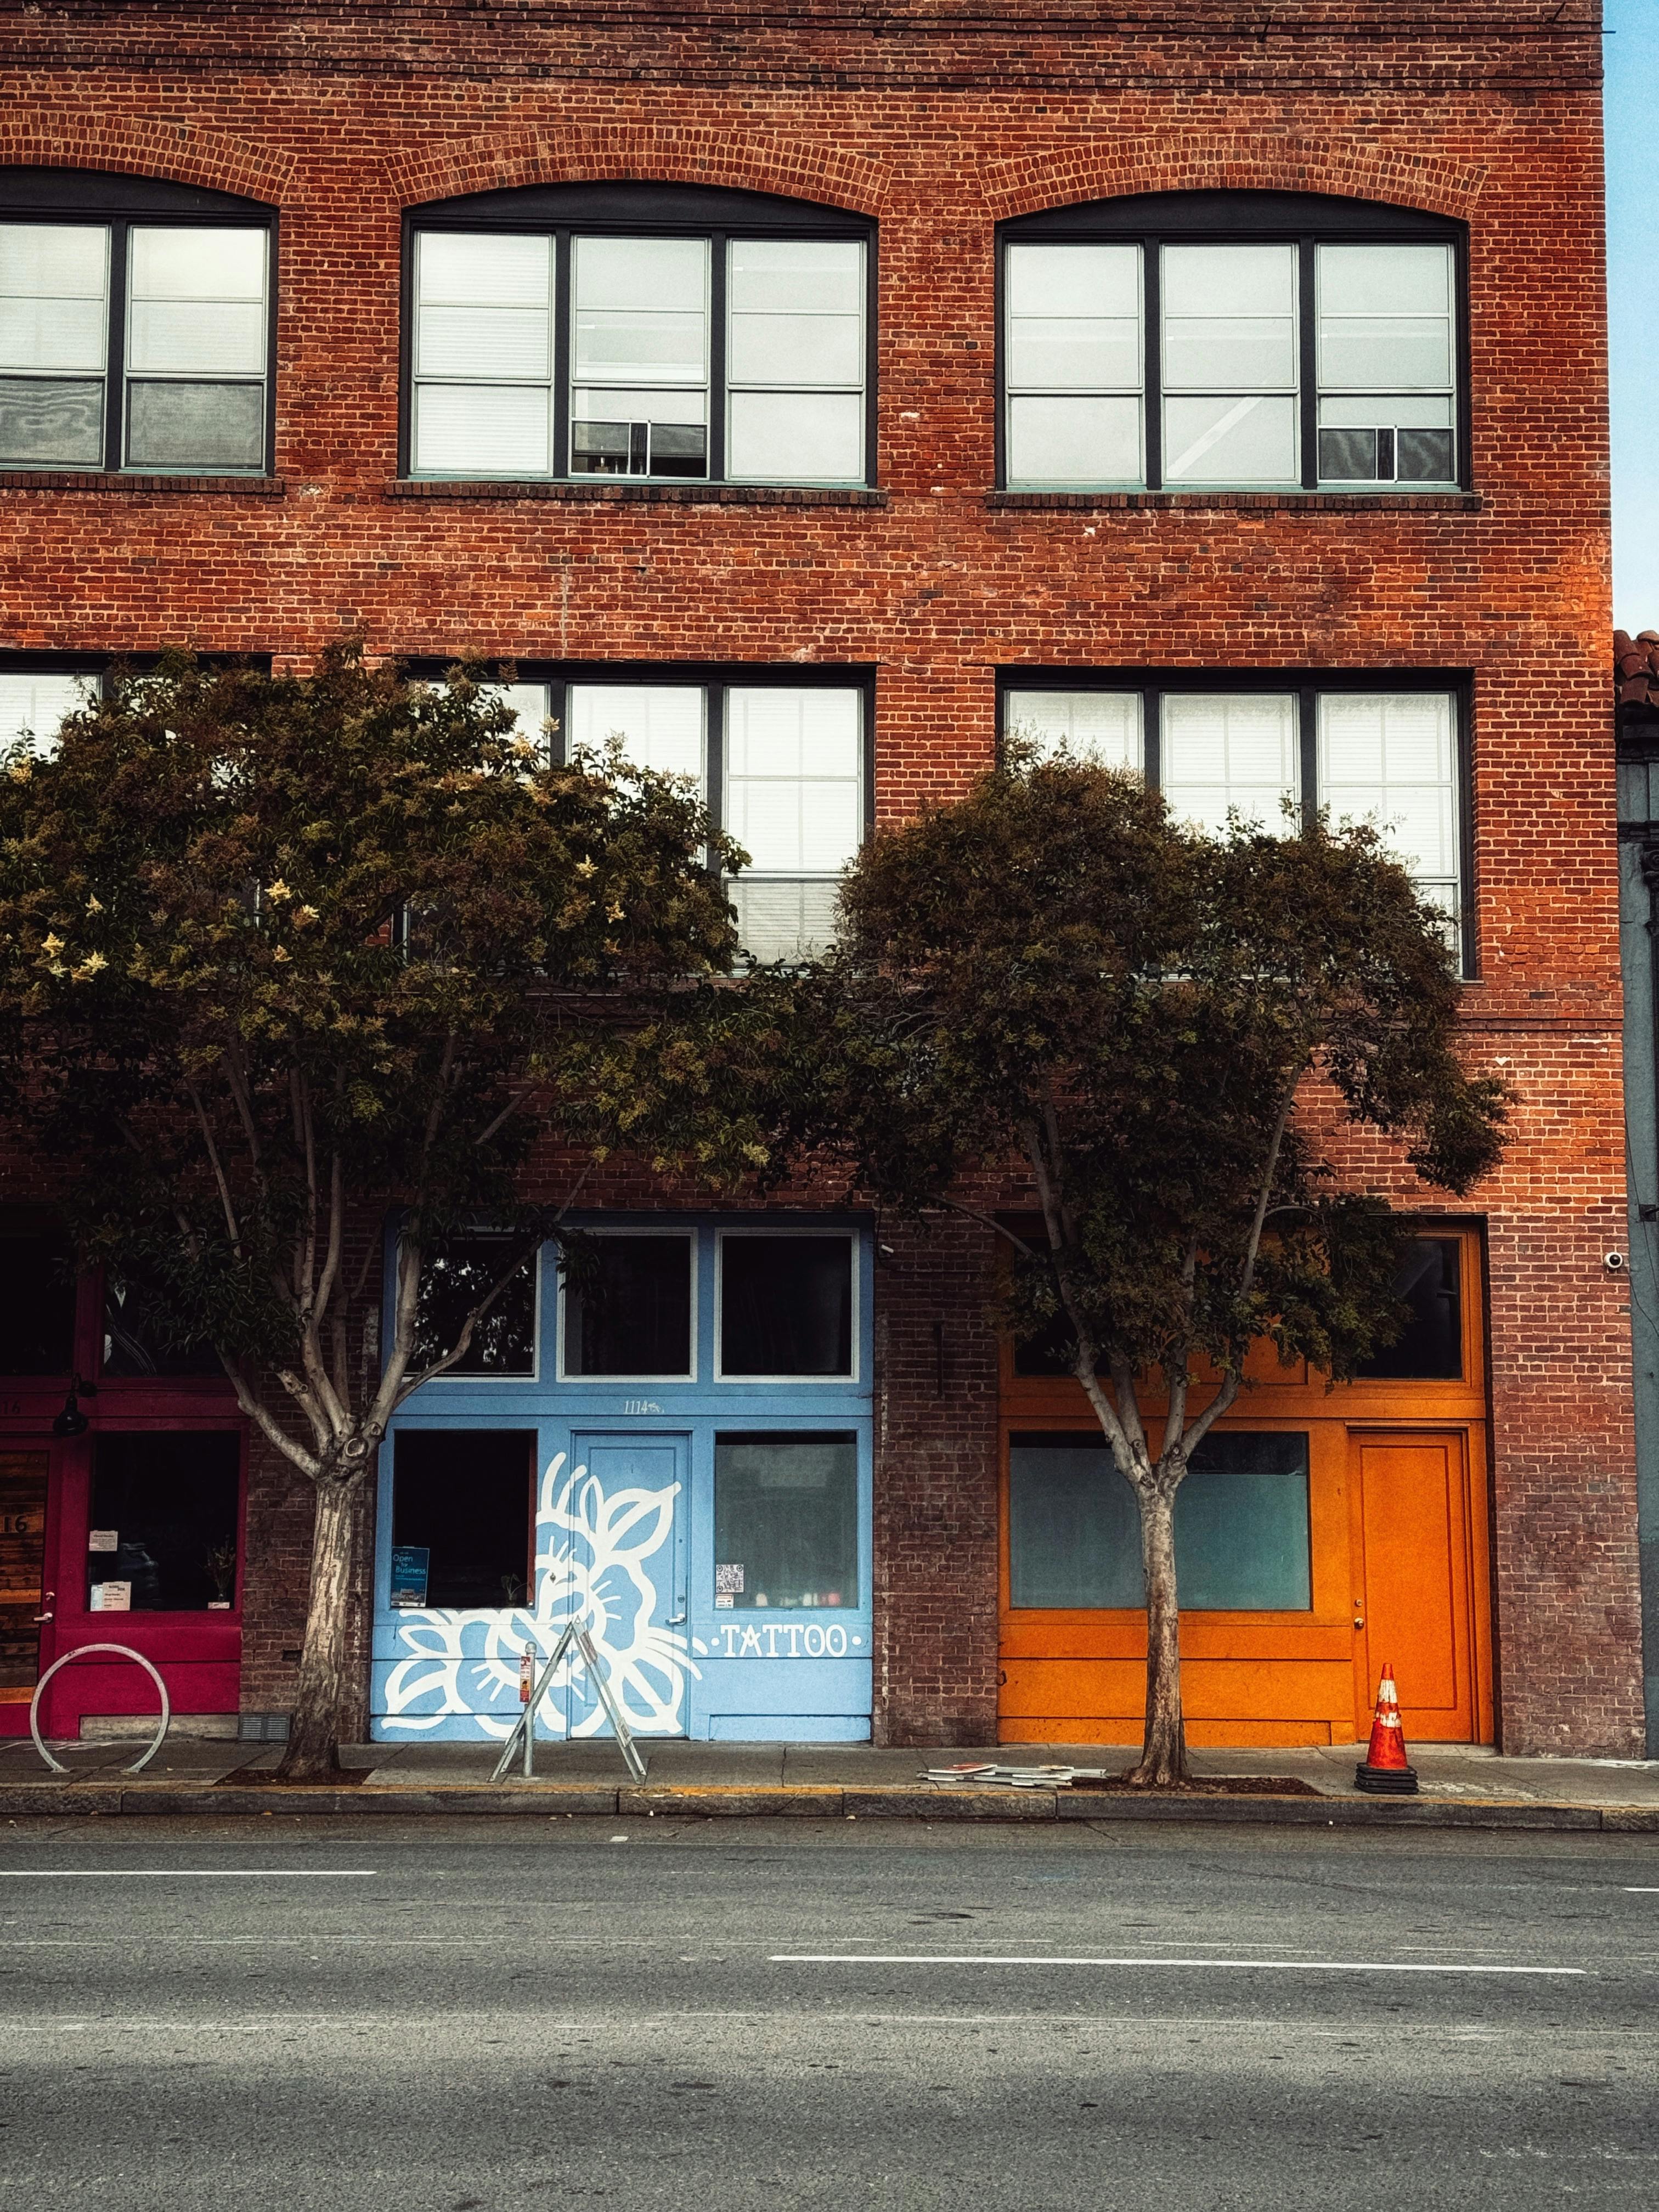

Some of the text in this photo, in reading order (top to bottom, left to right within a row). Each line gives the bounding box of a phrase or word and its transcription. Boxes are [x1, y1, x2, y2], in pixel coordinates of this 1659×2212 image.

[393, 1554, 413, 1563] Open
[395, 1566, 426, 1575] Business
[720, 1624, 847, 1657] TATTOO
